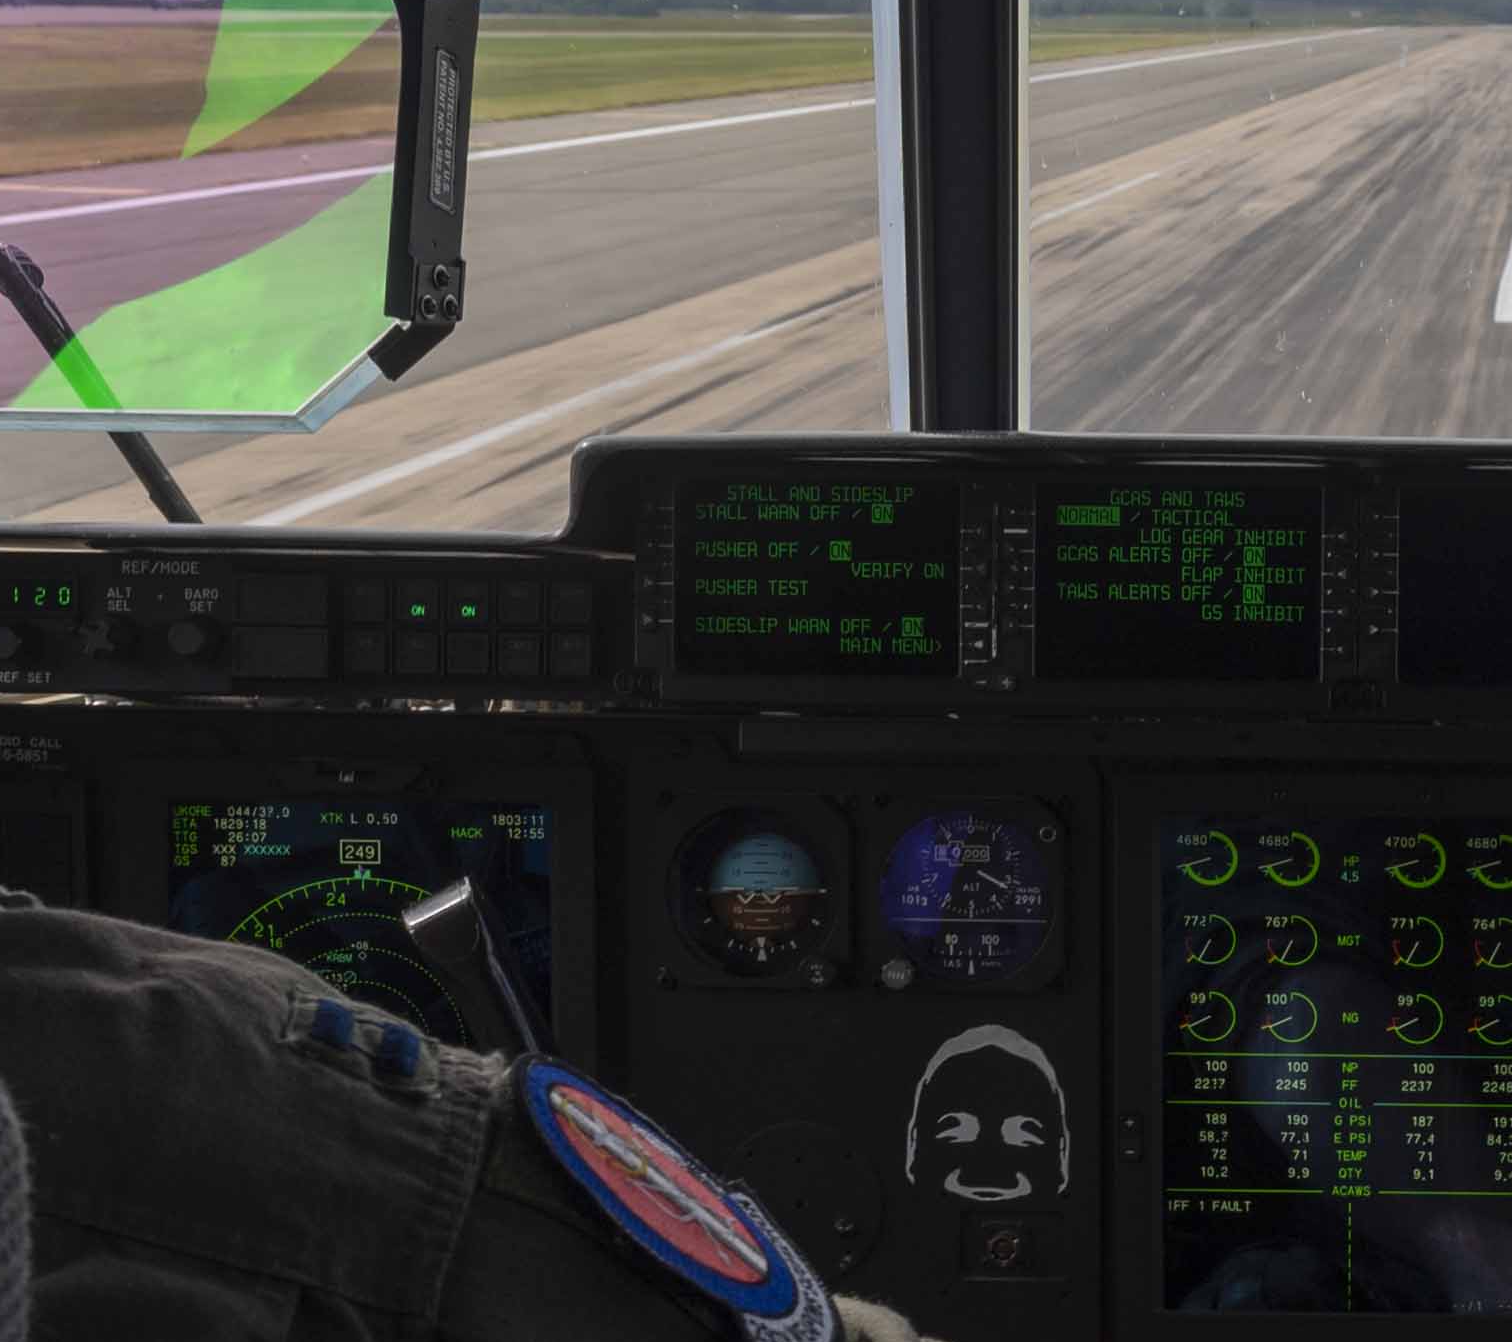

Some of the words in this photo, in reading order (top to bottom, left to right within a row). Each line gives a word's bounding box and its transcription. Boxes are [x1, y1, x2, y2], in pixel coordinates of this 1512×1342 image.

[727, 485, 776, 502] STALL
[790, 486, 820, 502] AND
[831, 487, 913, 503] SIDESLIP
[1161, 491, 1192, 506] AND
[1204, 491, 1246, 507] TAWS
[696, 505, 746, 520] STALL
[758, 505, 799, 520] WARN
[810, 505, 840, 520] OFF
[1152, 510, 1234, 526] TACTICAL
[1182, 530, 1224, 545] GEAR
[1234, 531, 1306, 546] INHIBIT
[696, 541, 758, 557] PUSHER
[768, 541, 799, 557] OFF
[1109, 547, 1171, 563] ALERTS
[122, 561, 199, 575] REF/MODE
[851, 563, 913, 578] VERIFY
[924, 563, 944, 578] ON
[1181, 567, 1224, 582] FLAP
[1234, 568, 1305, 583] INHIBIT
[108, 588, 132, 599] ALT
[696, 580, 758, 595] PUSHER
[768, 580, 808, 596] TEST
[1058, 583, 1098, 599] TAWS
[1109, 585, 1170, 600] ALERTS
[108, 601, 130, 612] SEL
[189, 601, 213, 612] SET
[411, 604, 425, 617] ON
[461, 605, 475, 618] ON
[1201, 605, 1222, 620] GS
[1234, 605, 1304, 621] INHIBIT
[696, 618, 778, 633] SIDESLIP
[789, 618, 830, 634] WARN
[840, 618, 870, 634] OFF
[840, 637, 881, 652] MAIN
[27, 672, 51, 683] SET
[30, 737, 61, 749] CALL
[214, 818, 266, 830] 1829:18
[321, 812, 343, 824] XTK
[492, 815, 543, 826] 1803:11
[229, 832, 266, 843] 26:07
[451, 828, 482, 838] HACK
[508, 828, 544, 839] 12:55
[345, 846, 375, 858] 249
[1391, 918, 1414, 929] 771
[1337, 935, 1361, 946] MGT
[1342, 1012, 1359, 1023] NG
[1342, 1080, 1358, 1091] FF
[1340, 1097, 1361, 1108] OIL
[1336, 1150, 1367, 1161] TEMP
[1332, 1186, 1371, 1196] ACAWS
[1212, 1201, 1252, 1212] FAULT
